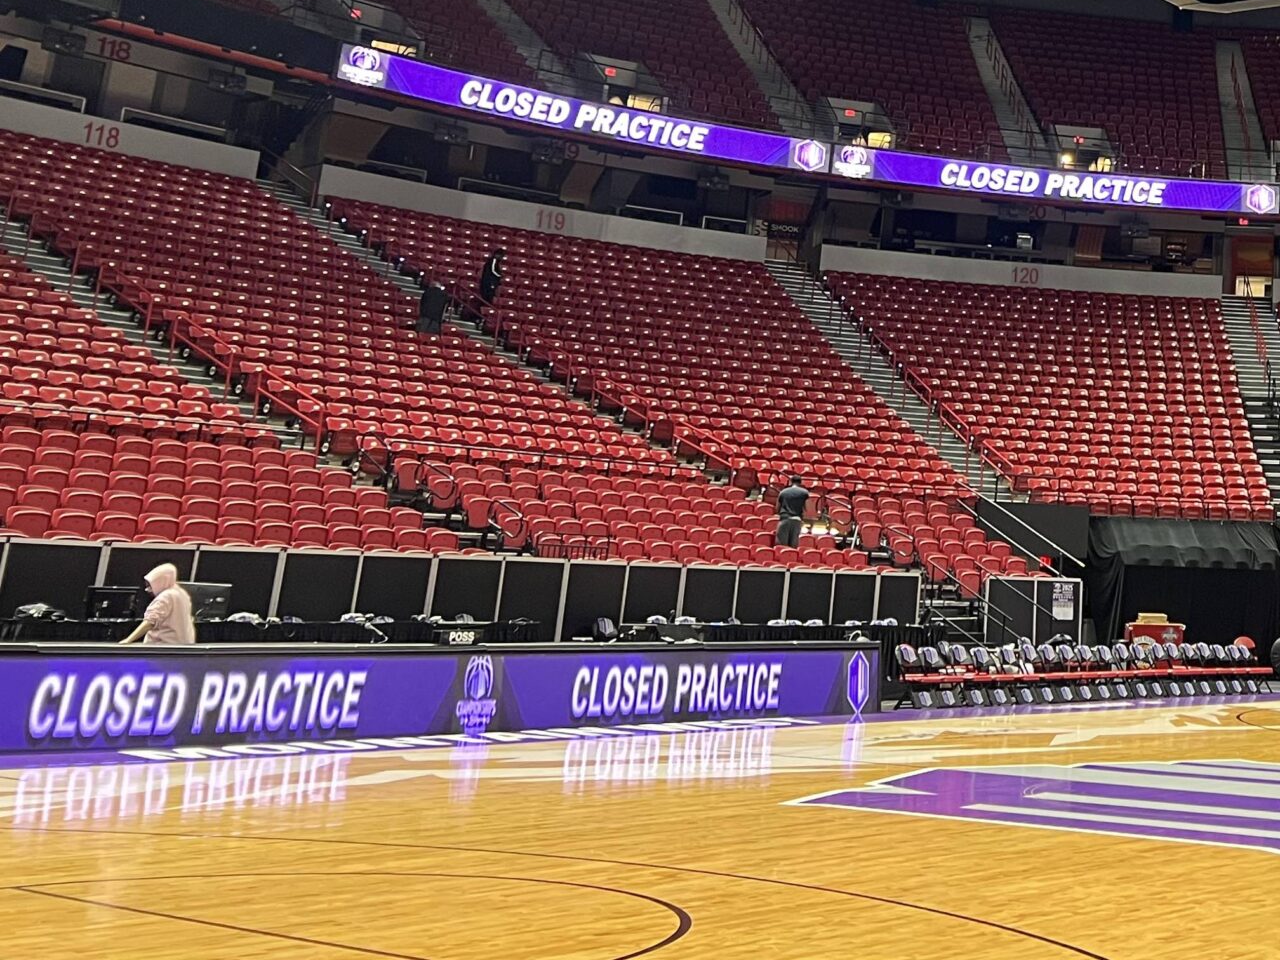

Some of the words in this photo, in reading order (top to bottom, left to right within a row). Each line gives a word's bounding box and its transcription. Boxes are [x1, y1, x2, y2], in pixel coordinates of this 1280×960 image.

[99, 37, 131, 60] 118
[460, 80, 570, 124] CLOSED
[574, 104, 709, 151] PRACTICE
[84, 121, 120, 148] 118
[941, 163, 1040, 193] CLOSED
[1045, 174, 1167, 204] PRACTICE
[536, 209, 565, 230] 119
[1012, 267, 1039, 285] 120
[449, 631, 475, 641] POSS
[28, 672, 188, 739] CLOSED
[191, 670, 368, 735] PRACTICE
[572, 666, 669, 718] CLOSED
[674, 663, 783, 713] PRACTICE
[120, 727, 633, 760] MOUNTAIN
[620, 717, 821, 733] WEST
